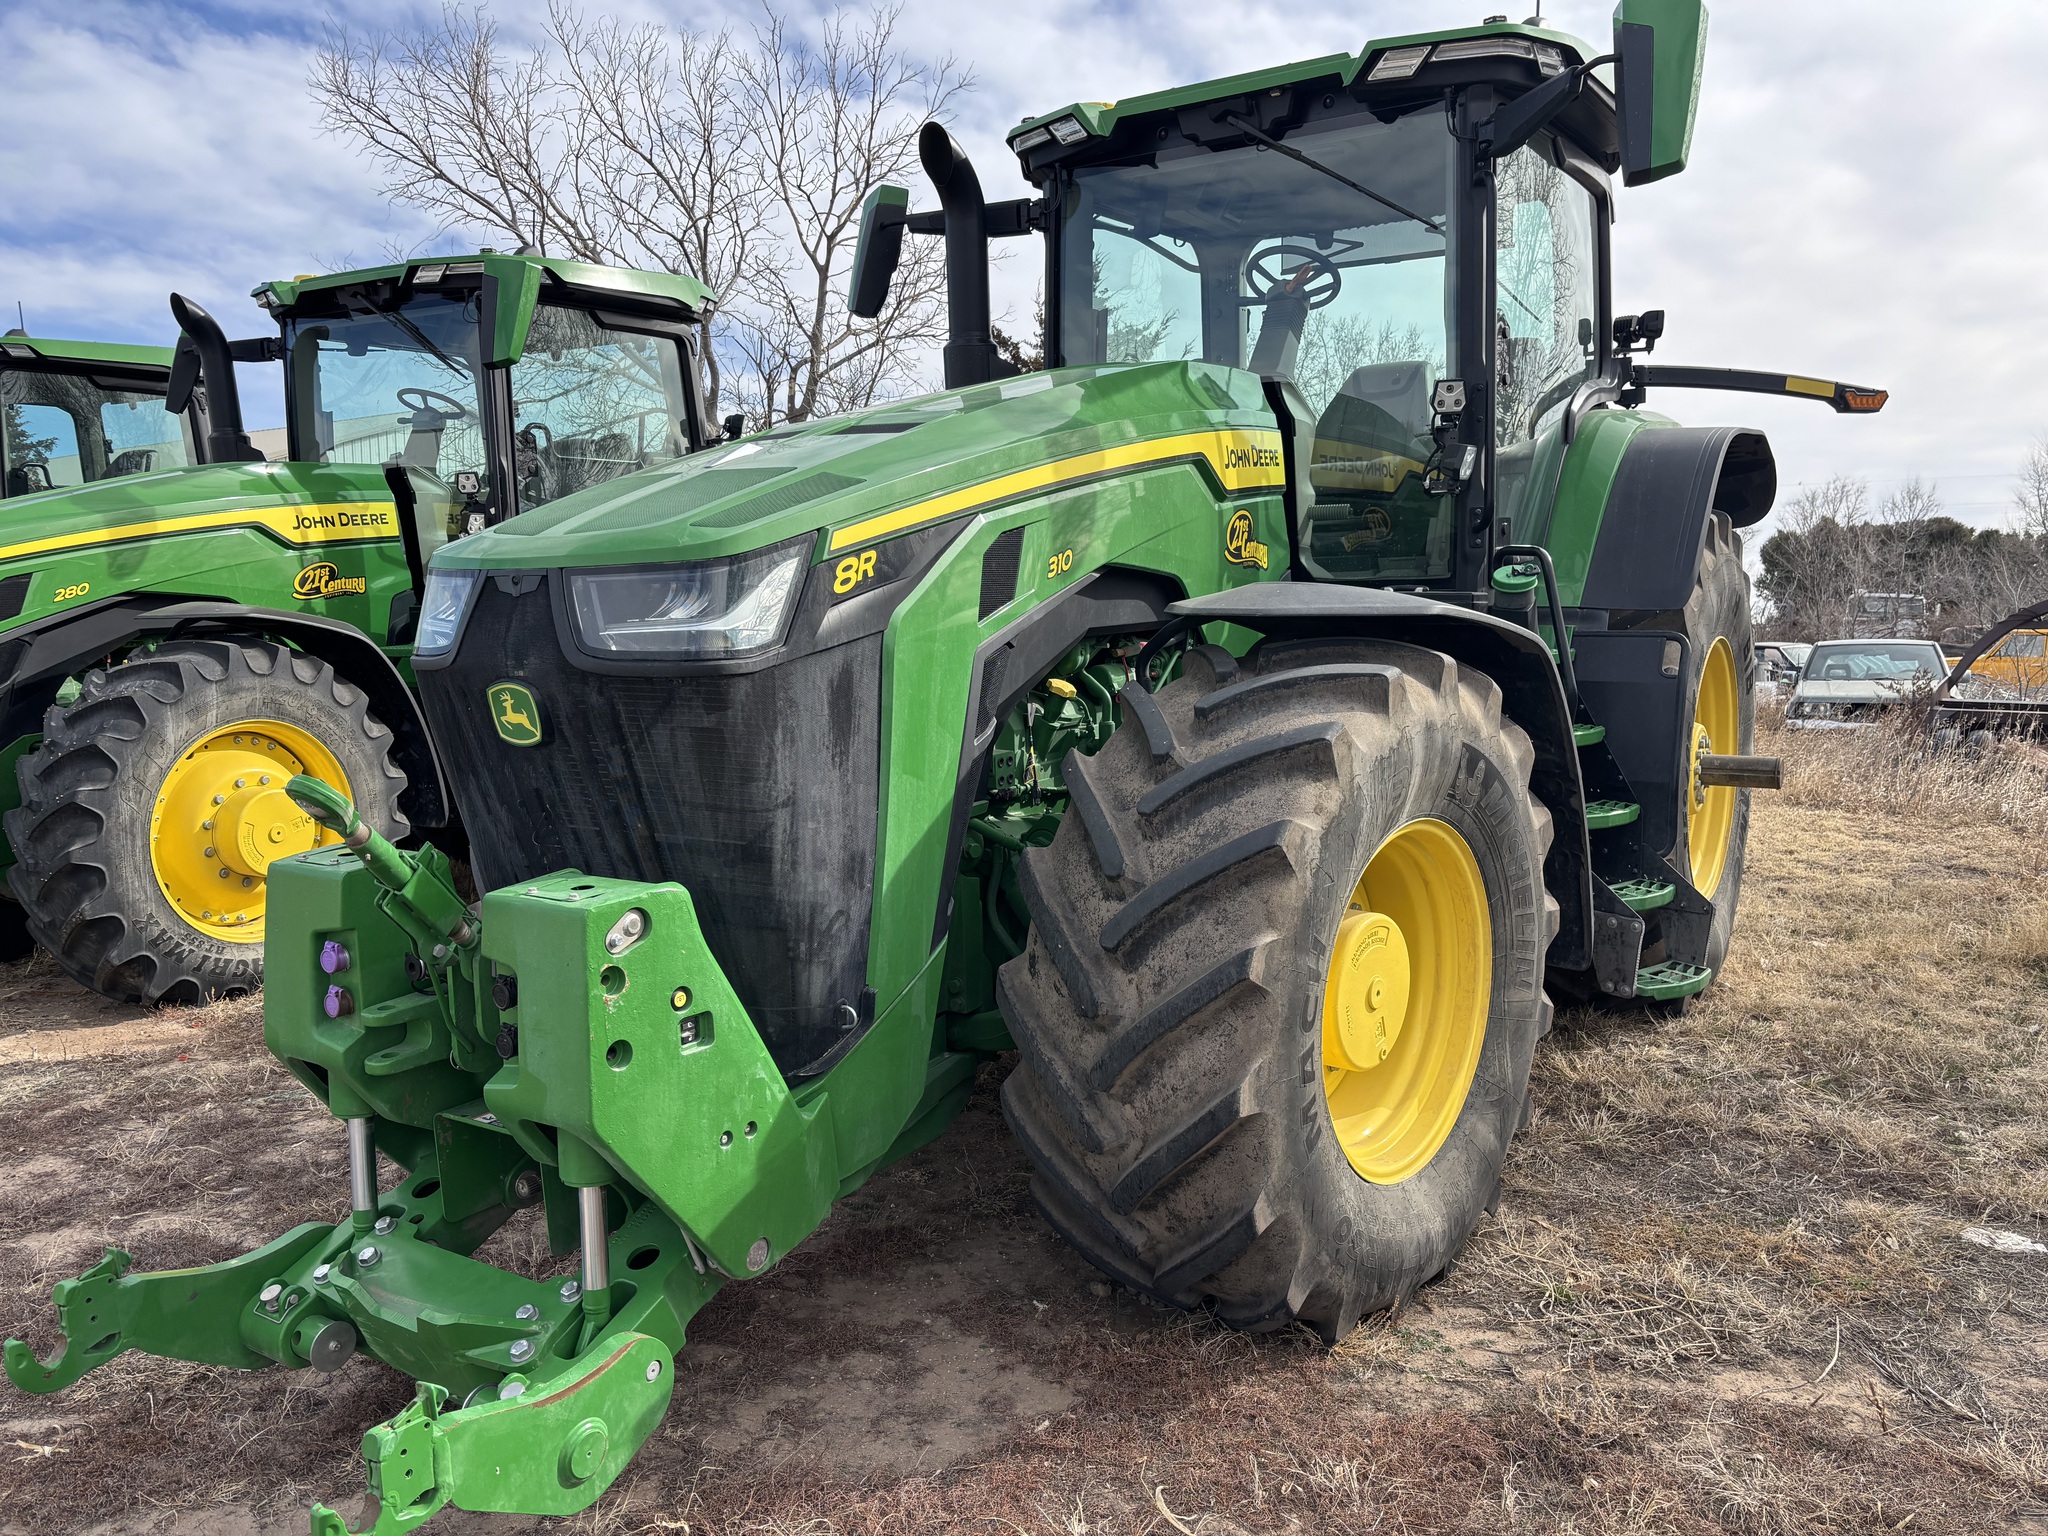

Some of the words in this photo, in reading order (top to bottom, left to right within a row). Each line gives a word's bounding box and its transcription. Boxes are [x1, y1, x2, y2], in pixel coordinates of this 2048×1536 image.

[1225, 445, 1250, 470] JOHN
[1250, 444, 1280, 467] DEERE
[292, 514, 336, 530] JOHN
[337, 512, 389, 527] DEERE
[834, 549, 877, 594] 8R
[1047, 549, 1073, 578] 310
[302, 566, 330, 591] 21st
[53, 582, 90, 603] 280
[1480, 779, 1537, 995] MICHELIN
[1298, 933, 1327, 1160] MACH
